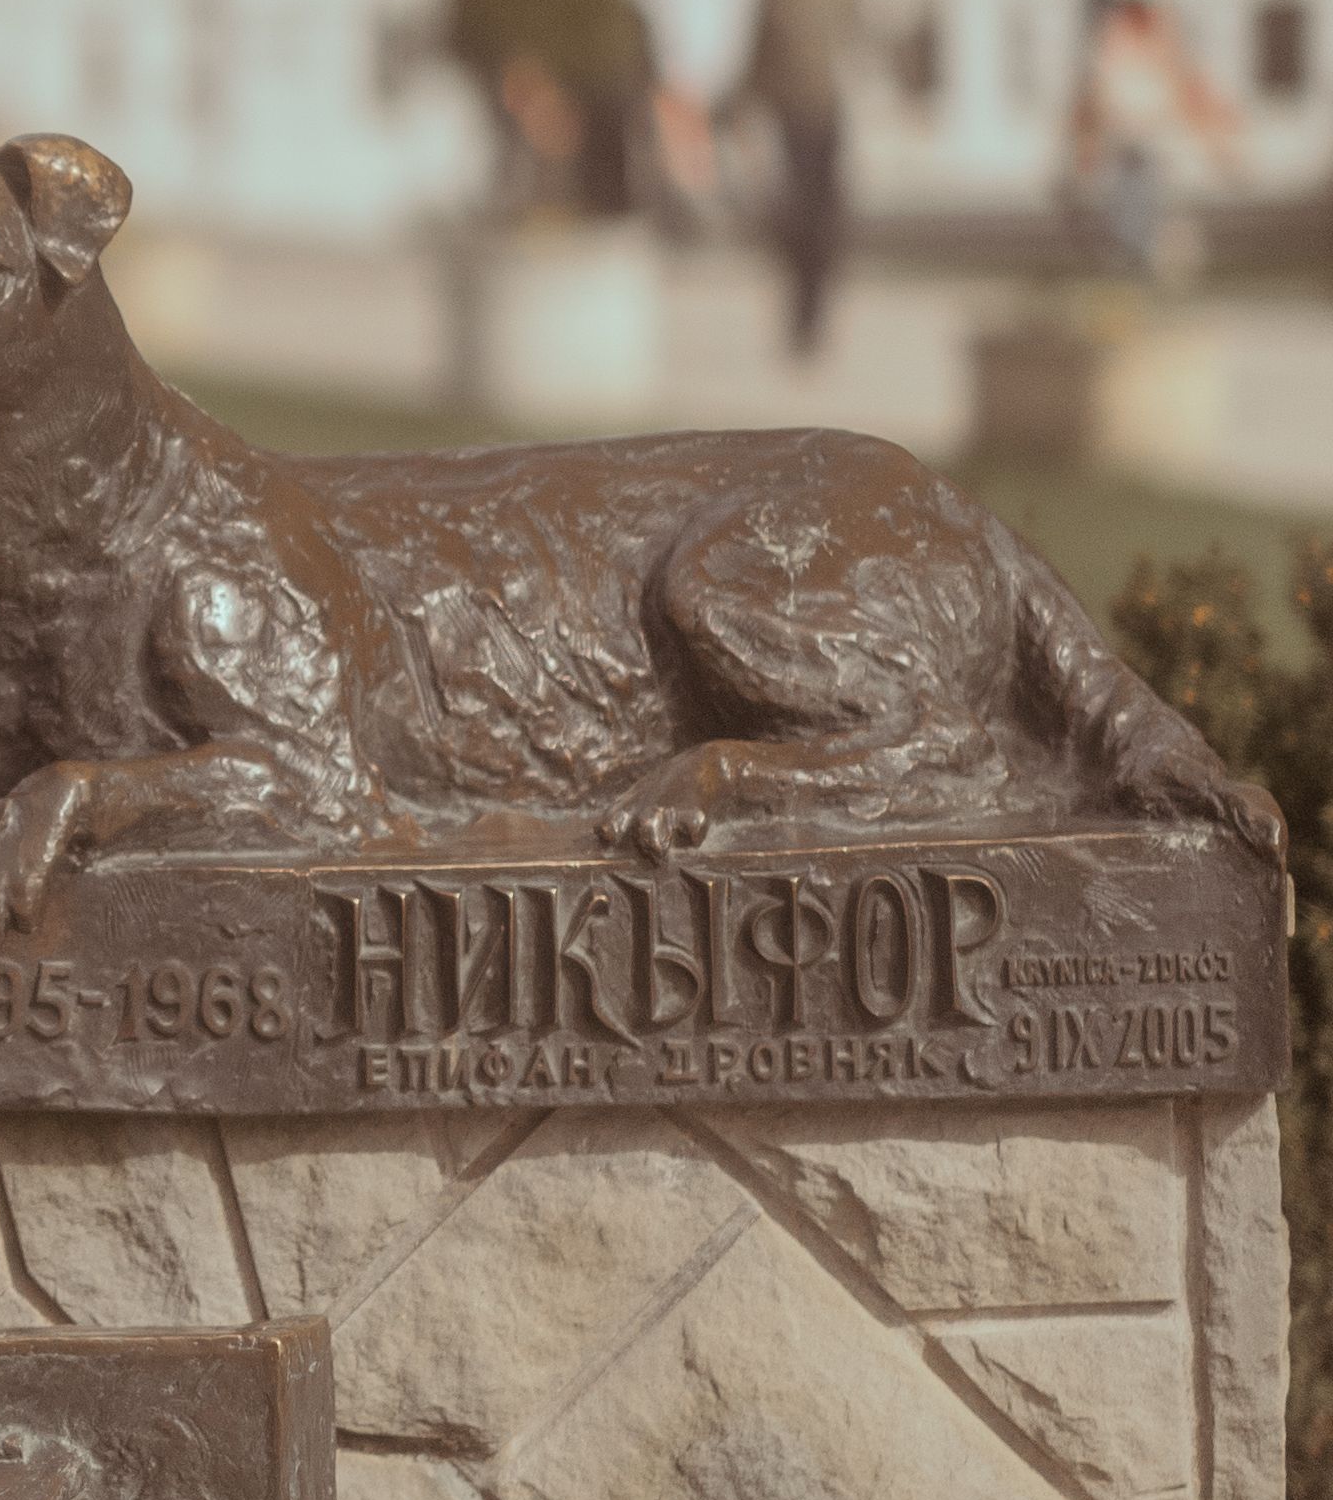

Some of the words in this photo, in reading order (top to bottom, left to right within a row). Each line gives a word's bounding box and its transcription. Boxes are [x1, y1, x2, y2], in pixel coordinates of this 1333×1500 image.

[654, 1036, 946, 1087] ДРОВНЯК
[1007, 1010, 1039, 1075] 9
[1113, 1000, 1239, 1070] 2005
